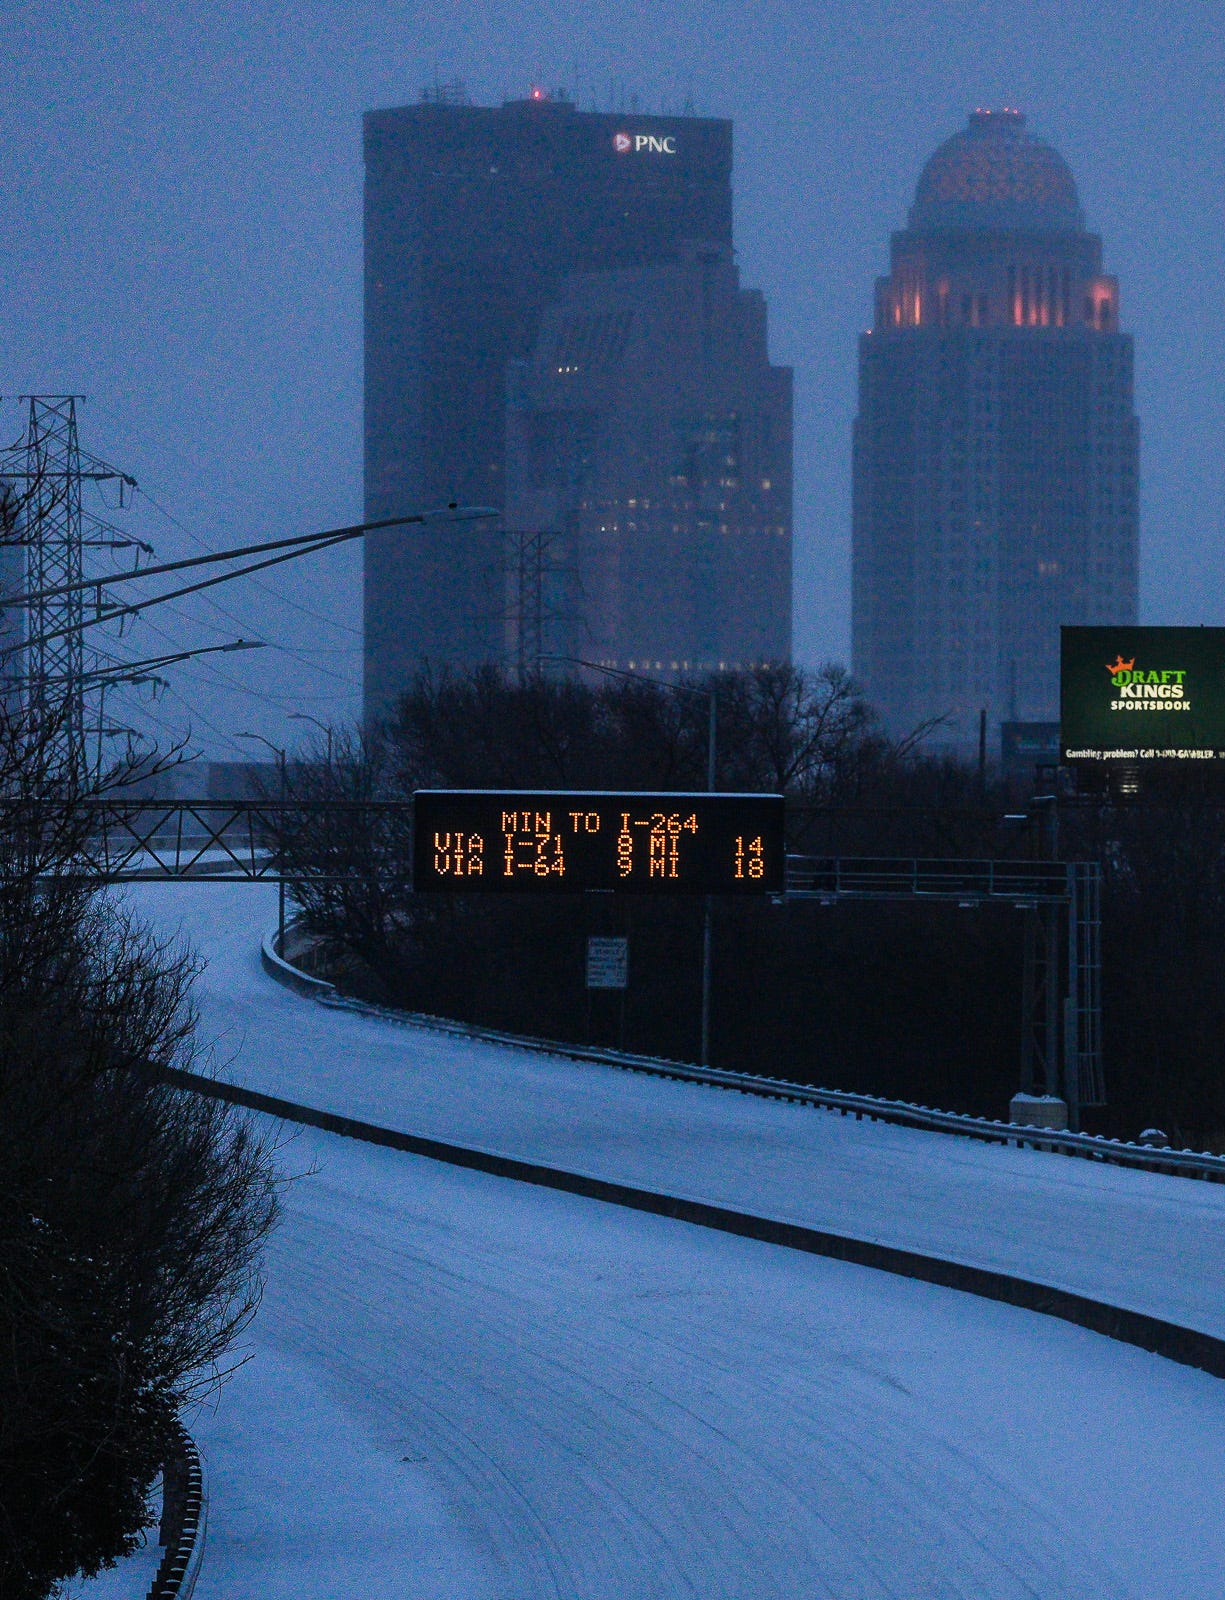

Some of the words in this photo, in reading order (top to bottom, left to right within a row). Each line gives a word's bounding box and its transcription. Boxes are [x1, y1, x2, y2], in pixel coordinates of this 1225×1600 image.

[635, 135, 676, 153] PNC
[1111, 670, 1186, 687] DRAFT
[1121, 683, 1184, 698] KINGS
[1111, 700, 1191, 710] SPORTSBOOK
[1066, 750, 1101, 759] Gambling
[1103, 750, 1138, 760] problem?
[1140, 749, 1154, 758] Call
[502, 812, 550, 832] MIN
[569, 813, 599, 832] TO
[621, 813, 698, 833] I-264
[435, 833, 483, 853] VIA
[505, 834, 563, 854] I-71
[618, 835, 632, 855] 8
[650, 835, 679, 855] MI
[736, 837, 763, 856] 14
[435, 855, 482, 875] VIA
[504, 856, 565, 876] I-64
[617, 857, 632, 876] 9
[650, 857, 678, 877] MI
[735, 858, 763, 878] 18
